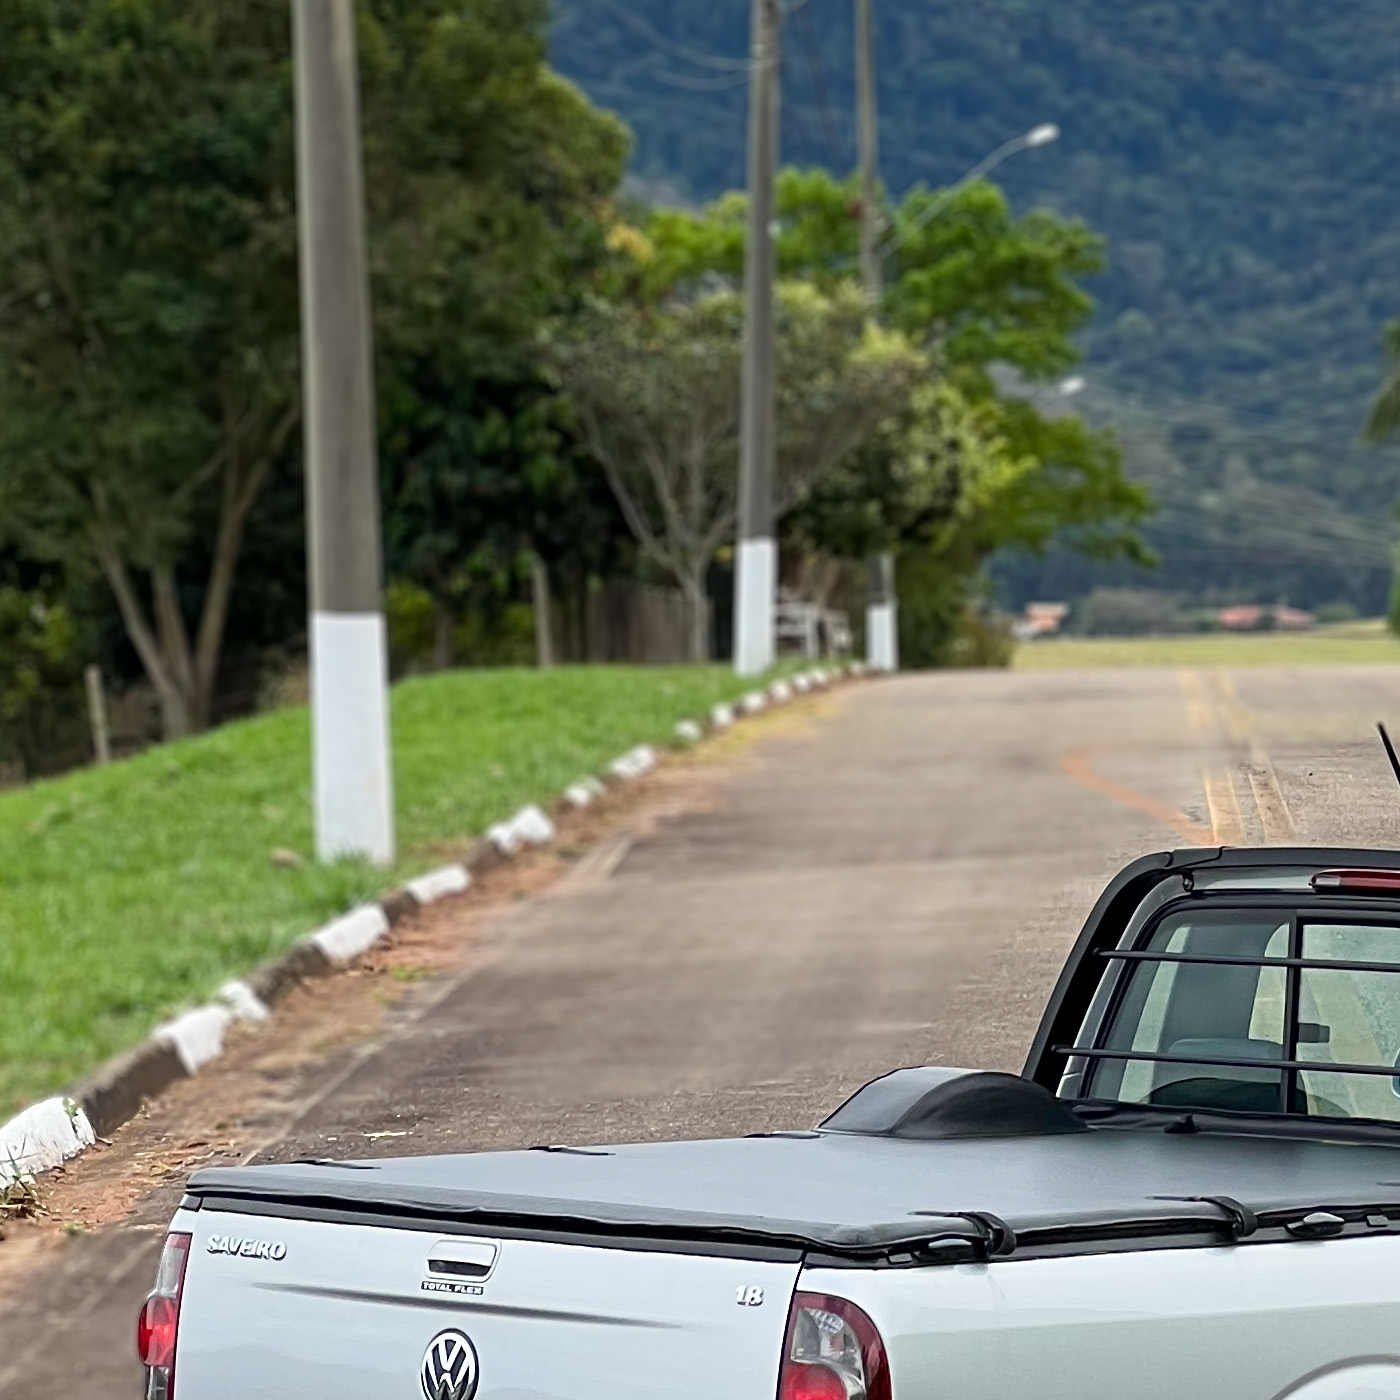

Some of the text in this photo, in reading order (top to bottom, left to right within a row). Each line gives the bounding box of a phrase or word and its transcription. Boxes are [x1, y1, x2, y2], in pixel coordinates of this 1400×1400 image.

[206, 1233, 287, 1261] SAVEIRO
[423, 1281, 482, 1295] TOTAL FLEX
